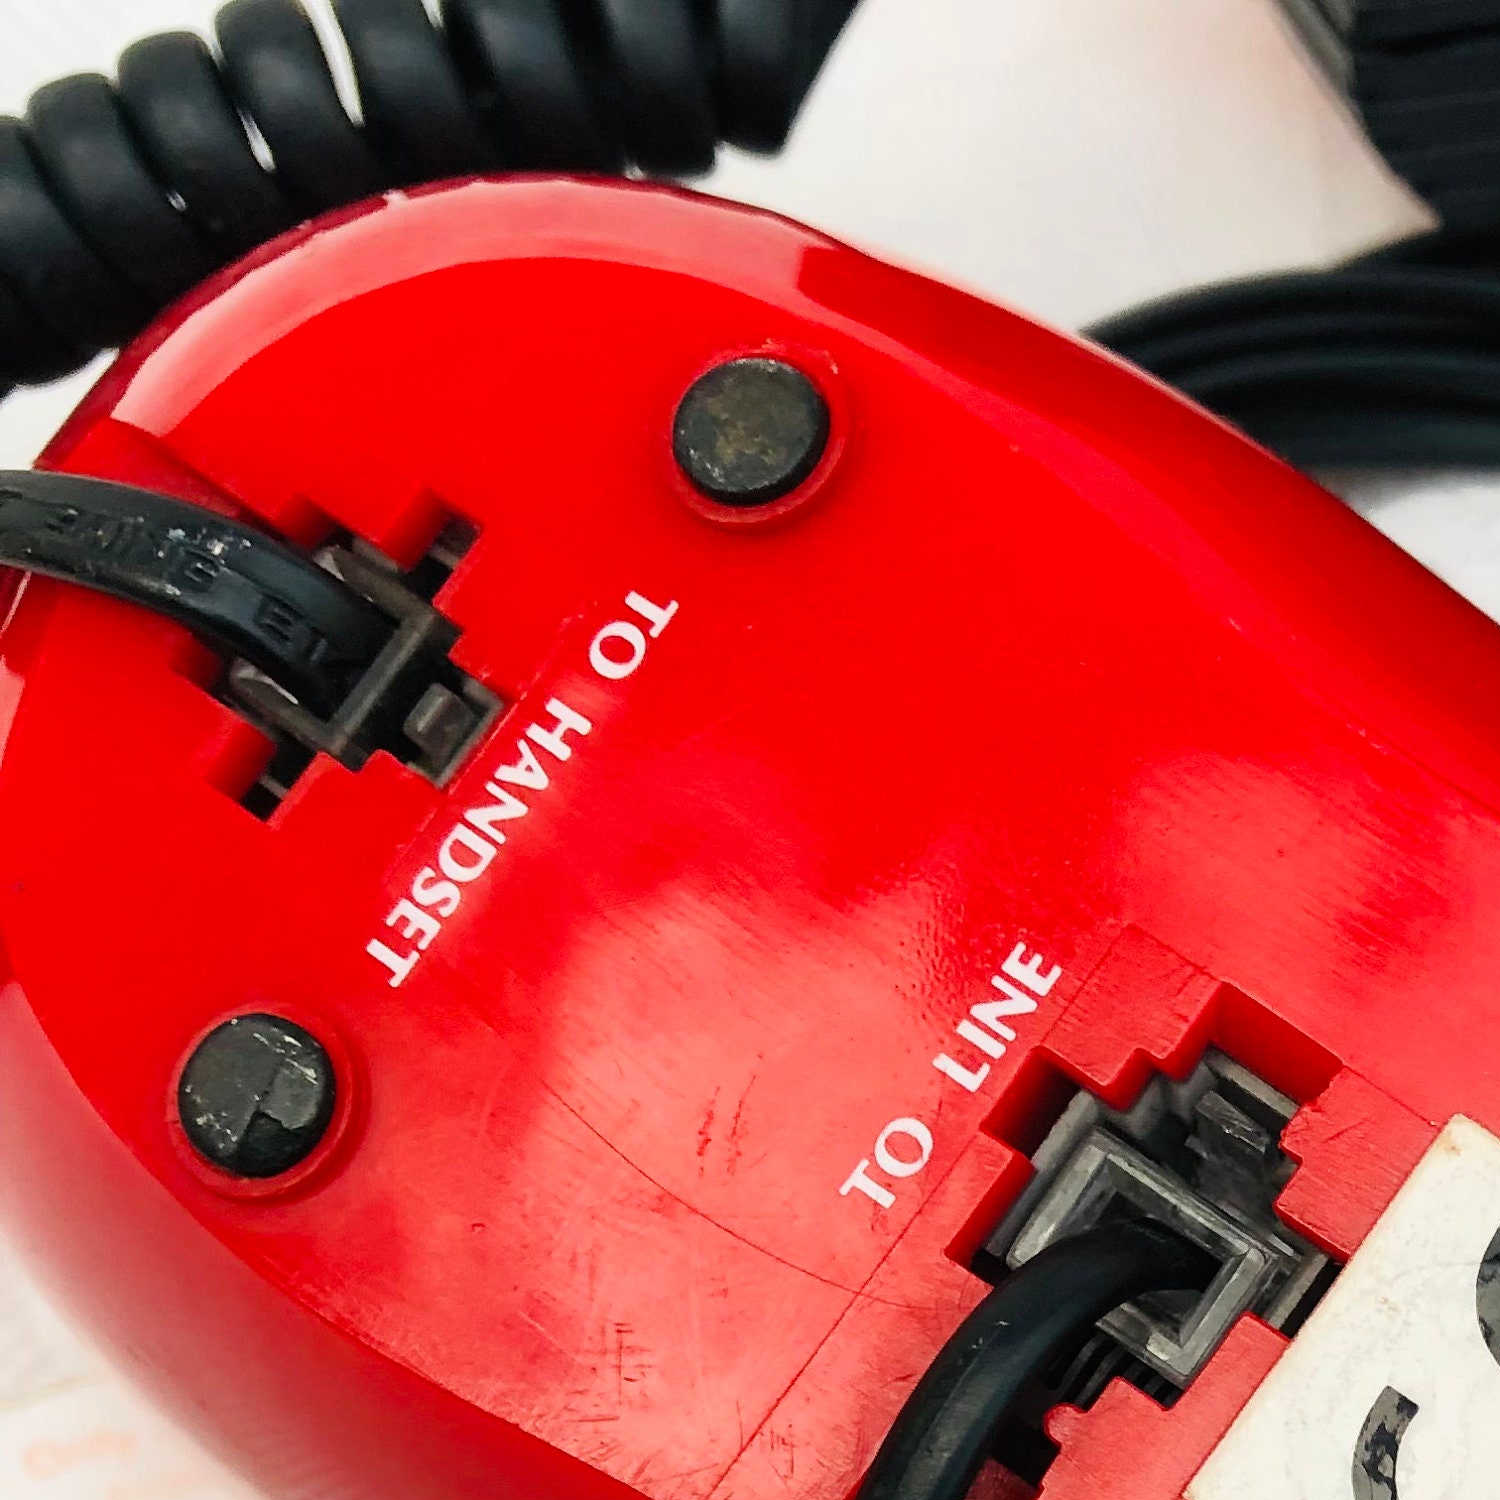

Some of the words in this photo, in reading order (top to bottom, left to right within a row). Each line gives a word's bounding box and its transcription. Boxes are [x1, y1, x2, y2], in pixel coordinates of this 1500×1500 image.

[589, 591, 679, 680] TO
[366, 697, 592, 988] HANDSET
[837, 1115, 934, 1210] TO
[931, 941, 1063, 1093] LINE
